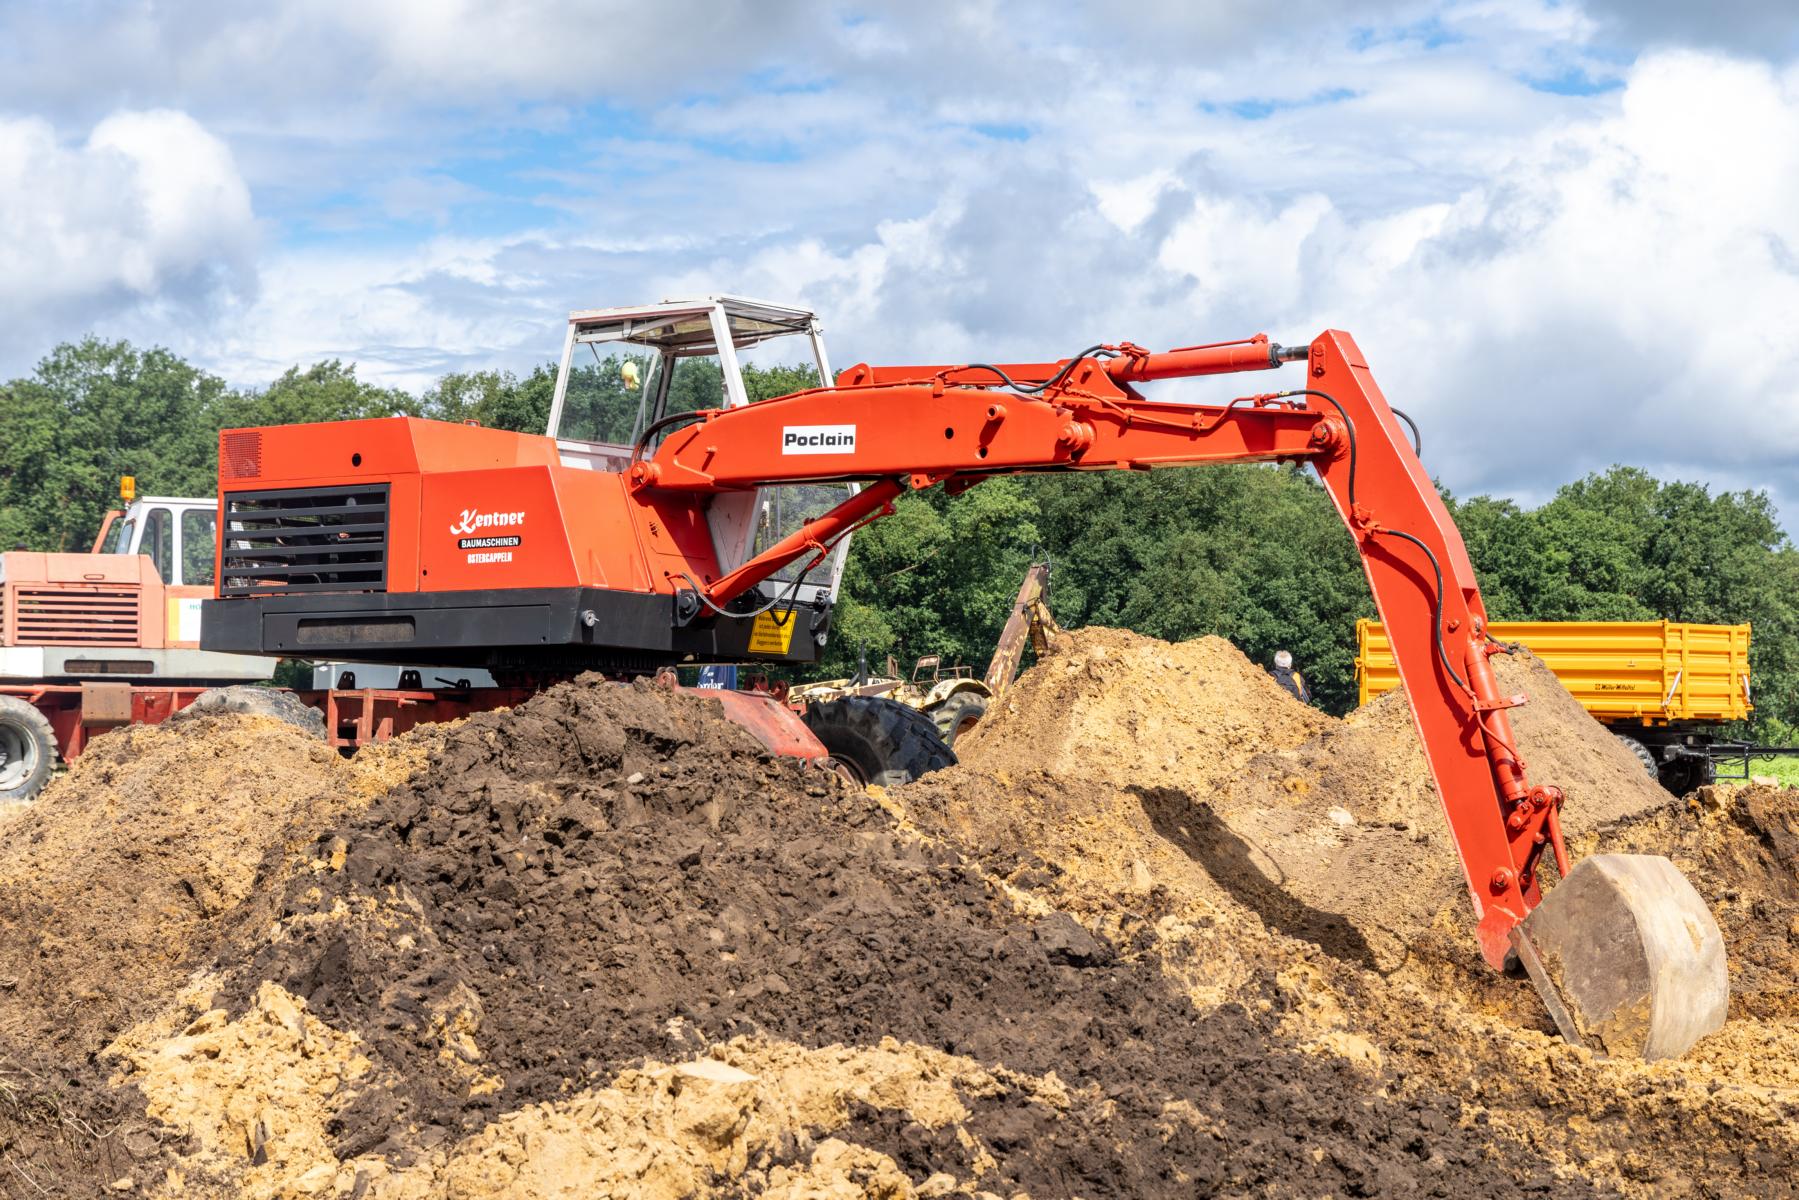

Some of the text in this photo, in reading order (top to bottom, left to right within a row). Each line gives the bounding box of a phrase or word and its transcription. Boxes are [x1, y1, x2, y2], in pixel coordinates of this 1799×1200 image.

[785, 432, 853, 446] Poclain
[450, 508, 525, 534] Kentner
[461, 537, 519, 548] BAUMASCHINEN
